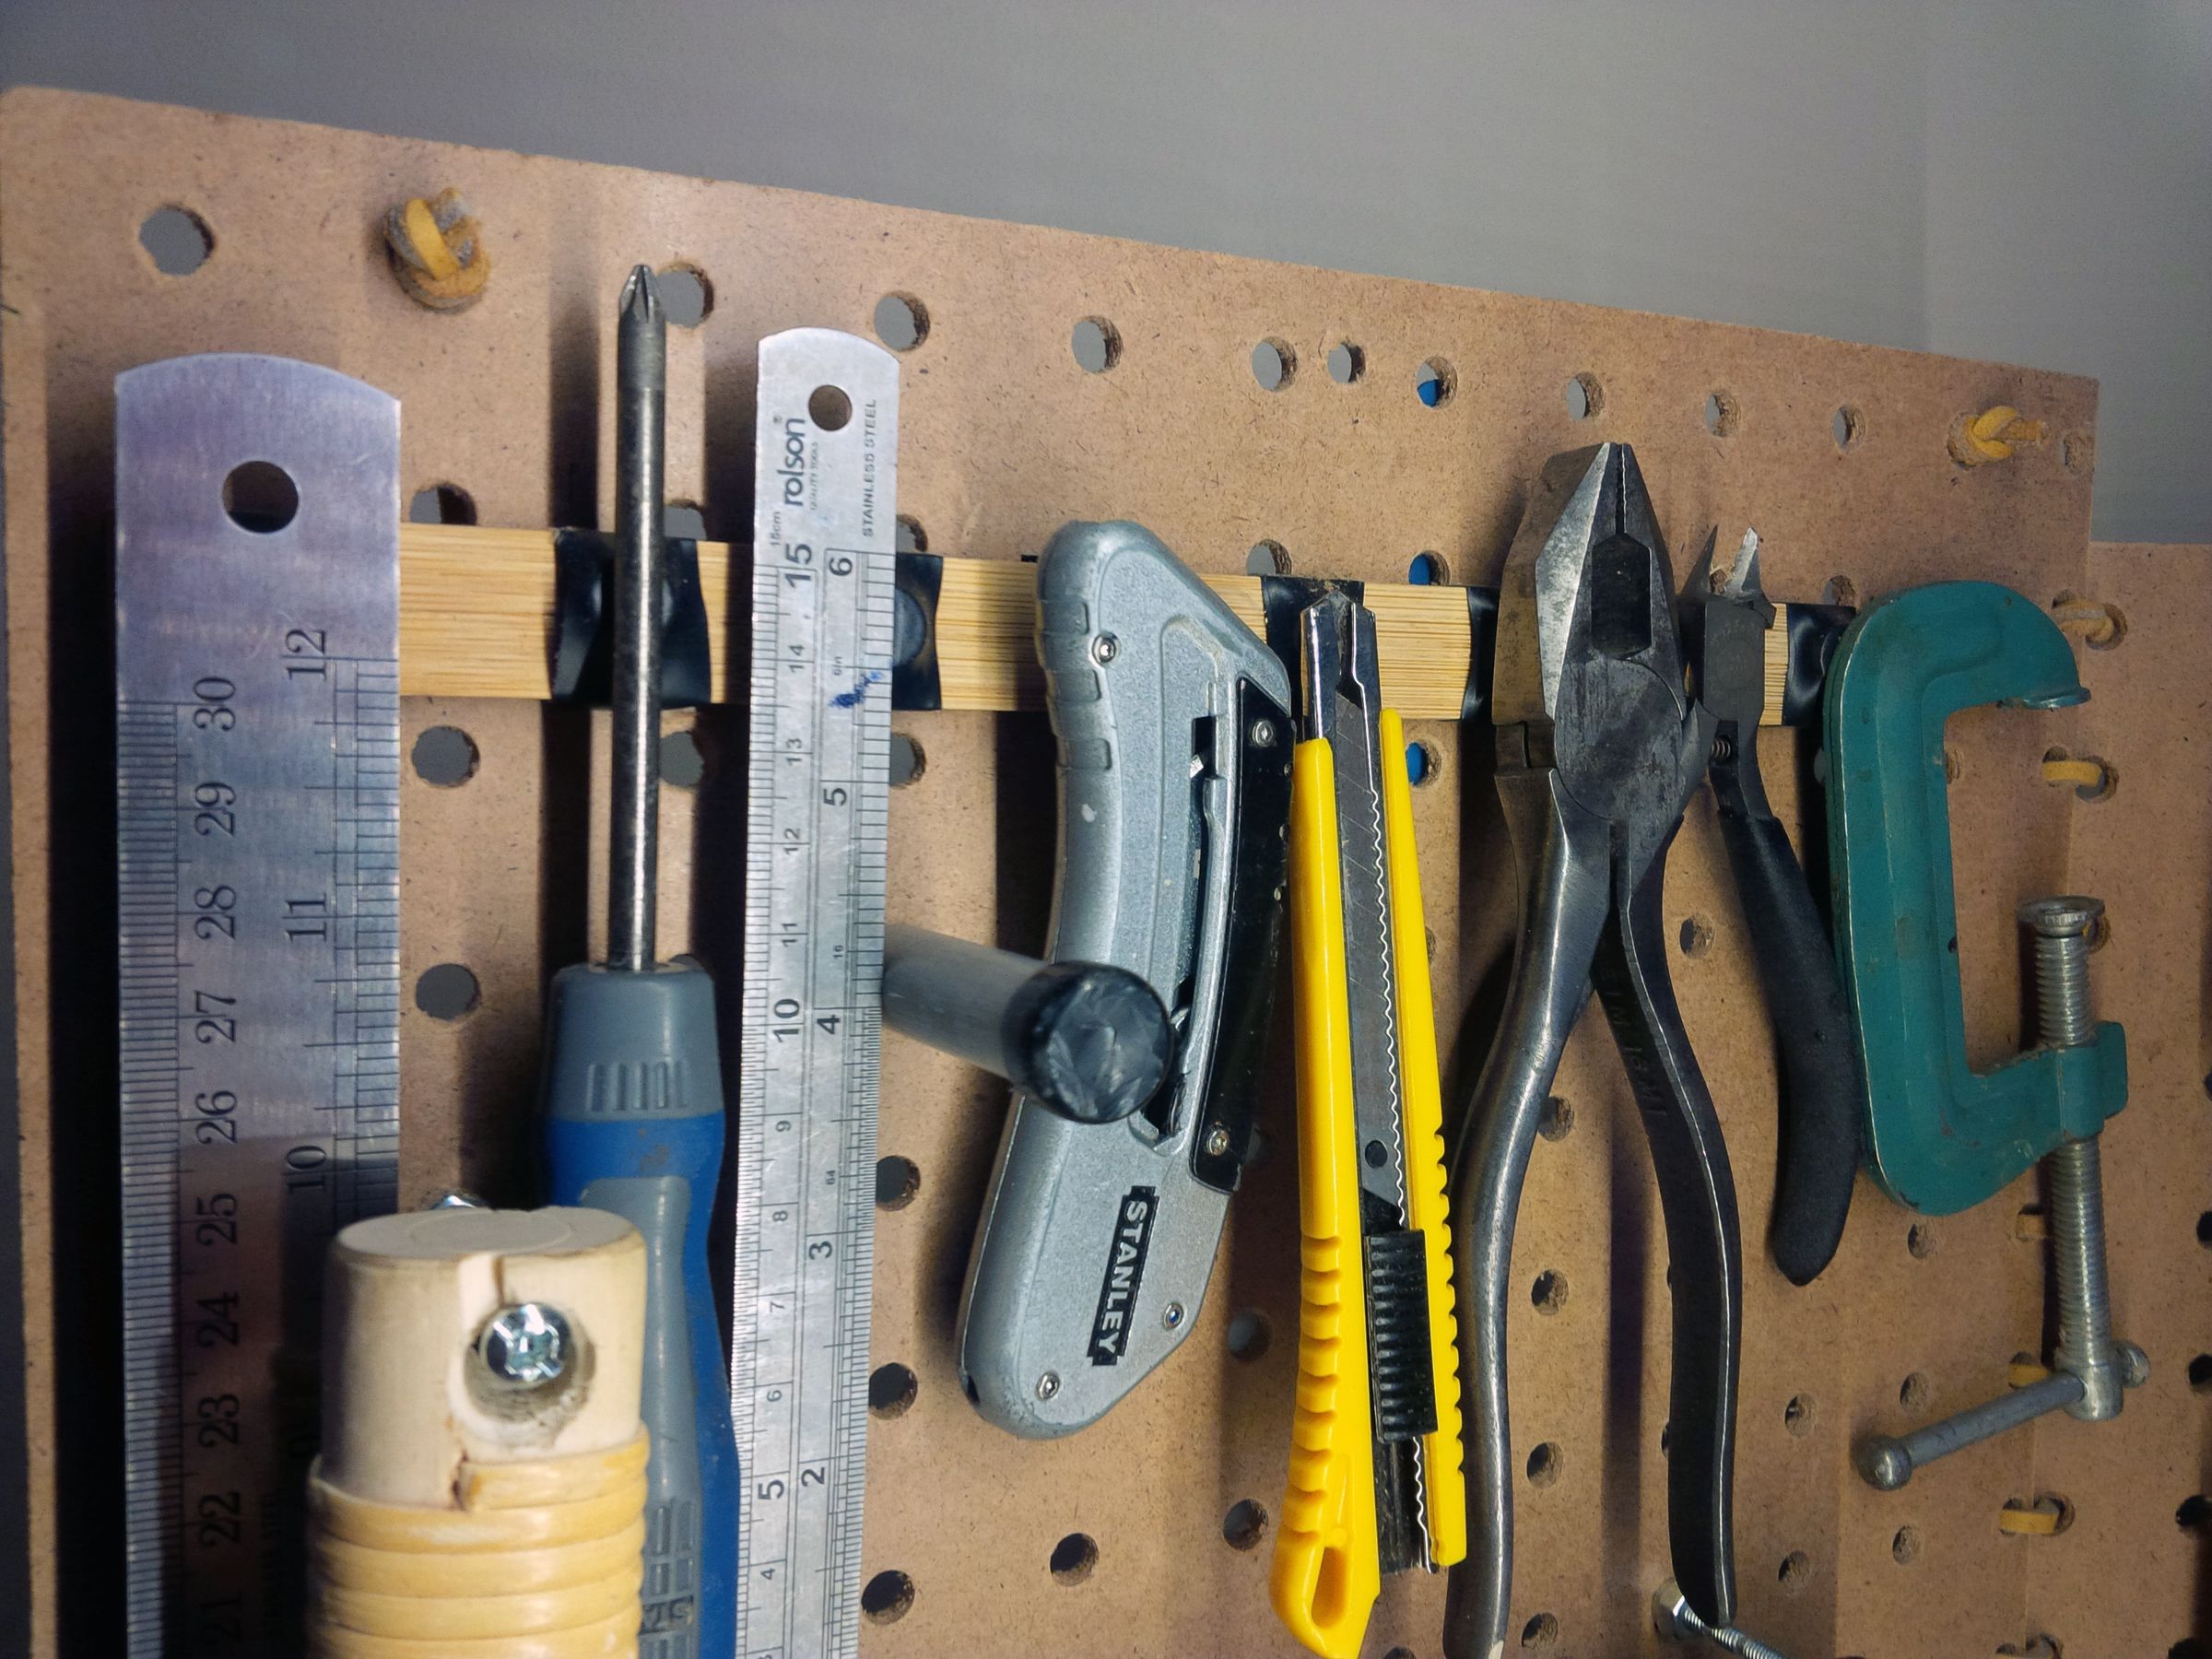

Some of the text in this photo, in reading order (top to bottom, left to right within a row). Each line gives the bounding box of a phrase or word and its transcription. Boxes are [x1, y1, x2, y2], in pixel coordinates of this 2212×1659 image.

[862, 399, 876, 536] STAINLESS STEEL
[284, 629, 326, 680] 12
[193, 677, 236, 731] 30
[194, 782, 236, 836] 29
[194, 885, 236, 939] 28
[284, 894, 327, 943] 11
[194, 990, 237, 1044] 27
[800, 558, 853, 1486] 2 3 4 5 6
[758, 543, 812, 1580] 4 5 6 7 8 9 10 11 12 13 14 15
[194, 1090, 237, 1145] 26
[285, 1146, 326, 1193] 10
[195, 1193, 238, 1245] 25
[1098, 1201, 1148, 1354] STANLEY
[196, 1292, 238, 1347] 24
[197, 1394, 240, 1447] 23
[198, 1491, 241, 1547] 22
